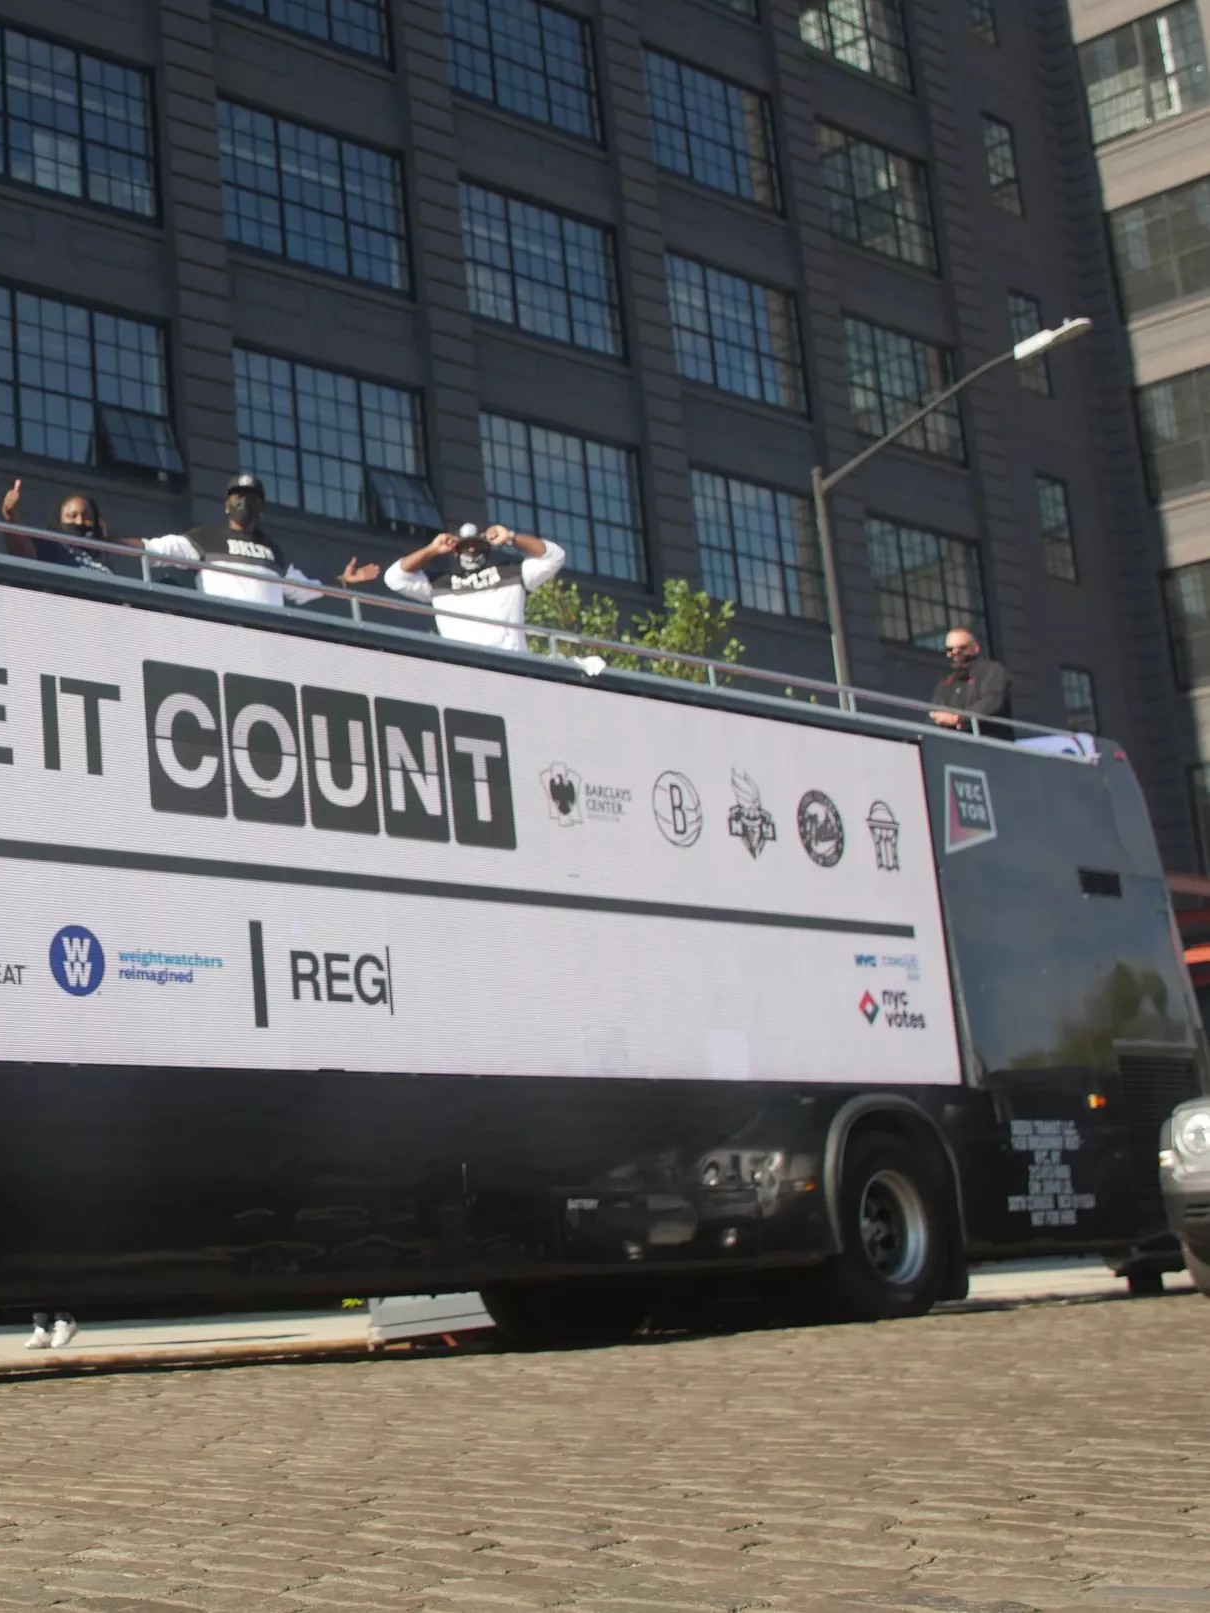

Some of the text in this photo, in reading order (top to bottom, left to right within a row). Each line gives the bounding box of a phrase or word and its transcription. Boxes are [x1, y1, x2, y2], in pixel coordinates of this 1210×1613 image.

[40, 674, 120, 776] IT
[153, 692, 504, 826] COUNT
[584, 783, 633, 802] BARCLAYS
[954, 780, 983, 802] VEC
[586, 800, 626, 815] CENTER
[669, 784, 687, 834] B
[957, 801, 987, 822] TOR
[62, 936, 91, 962] W
[118, 949, 224, 968] weightwatchers
[62, 960, 92, 988] W
[118, 965, 194, 986] reimagined
[289, 950, 388, 1006] REG
[881, 989, 909, 1011] nyc
[885, 1011, 926, 1030] votes
